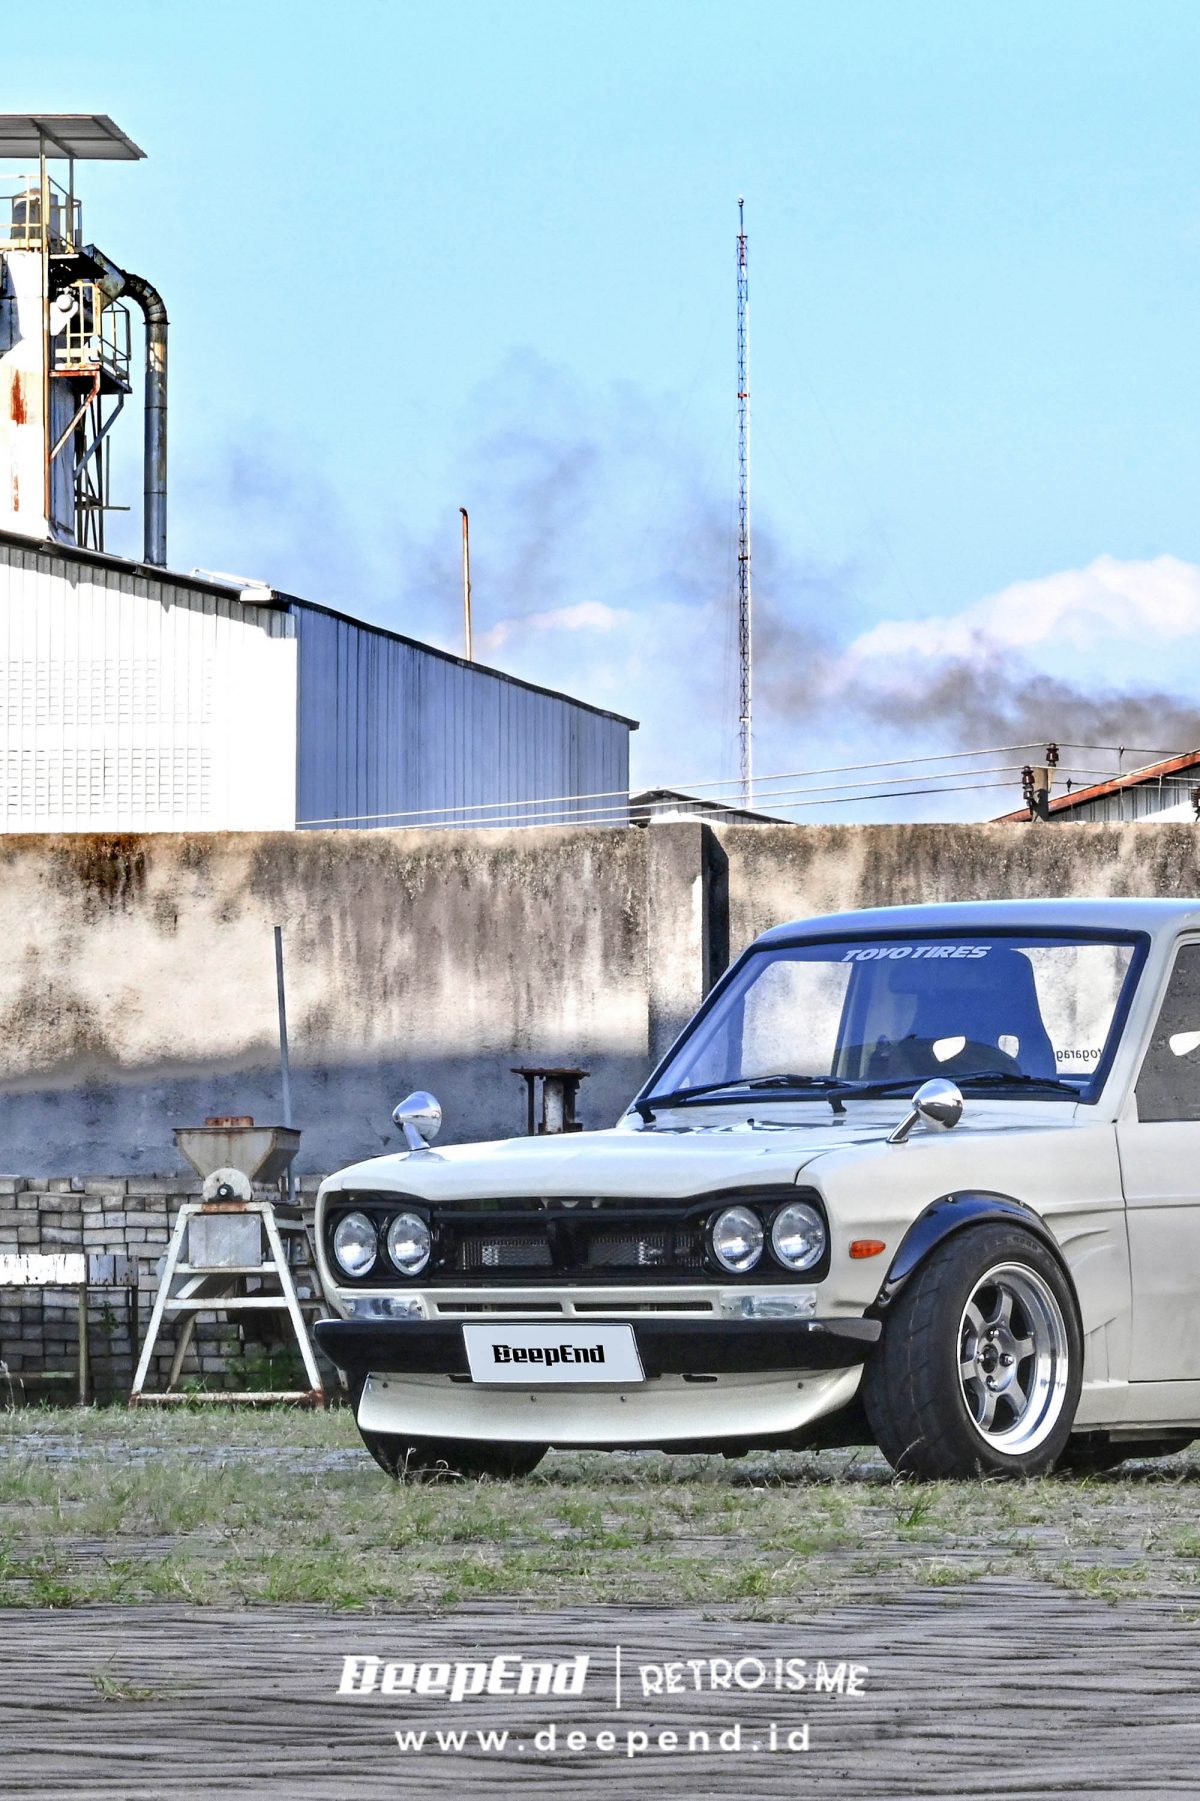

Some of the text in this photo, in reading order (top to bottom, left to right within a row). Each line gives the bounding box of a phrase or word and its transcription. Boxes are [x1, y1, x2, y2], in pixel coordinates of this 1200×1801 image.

[841, 945, 992, 962] TOYO TIRES
[491, 1344, 605, 1366] DeepEnd
